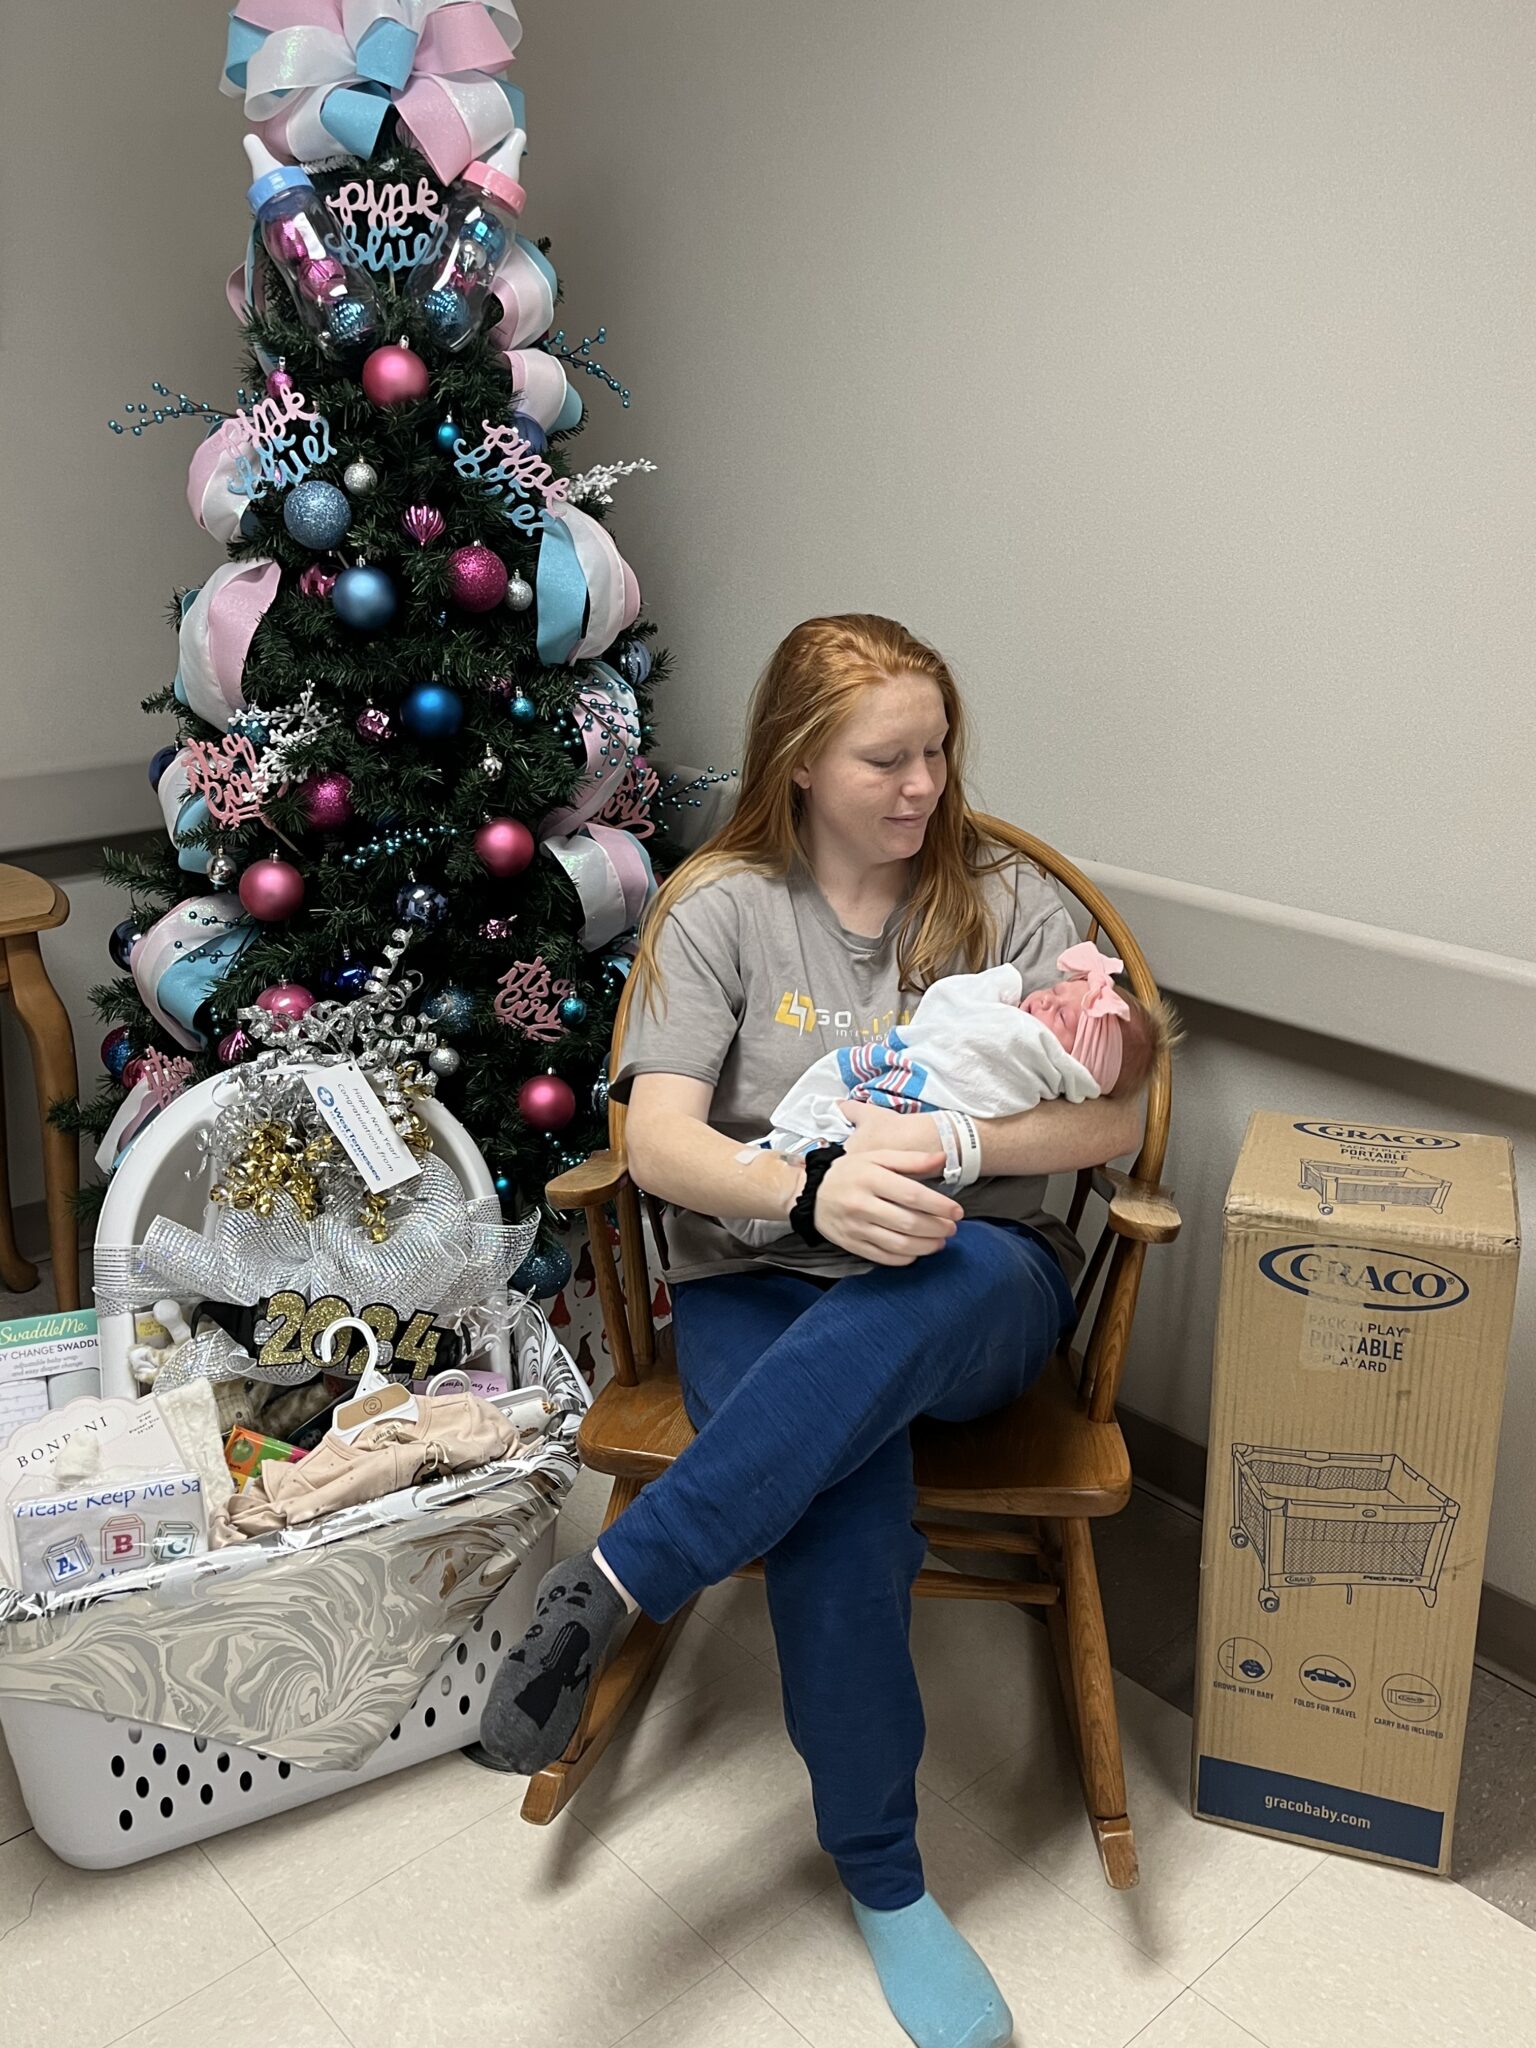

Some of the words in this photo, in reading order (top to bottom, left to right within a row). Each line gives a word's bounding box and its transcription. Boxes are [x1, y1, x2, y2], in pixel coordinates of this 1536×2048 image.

[352, 1087, 372, 1115] Happy
[370, 1116, 385, 1136] New
[337, 1083, 380, 1154] Congratulations
[377, 1150, 395, 1172] from
[1318, 1126, 1443, 1146] GRACO
[333, 1106, 351, 1133] West
[349, 1131, 381, 1181] Tennessee
[1340, 1148, 1408, 1161] PORTABLE
[1350, 1156, 1398, 1164] PLAYARD
[1290, 1253, 1447, 1299] GRACO
[0, 1318, 87, 1346] SwaddleMe
[257, 1289, 442, 1380] 2024
[1367, 1323, 1405, 1338] PLAY
[10, 1345, 56, 1360] CHANGE
[1310, 1329, 1404, 1361] PORTABLE
[1323, 1355, 1388, 1373] PLAYARD
[16, 1415, 108, 1468] BONPNI
[86, 1488, 136, 1508] Keep
[143, 1483, 175, 1500] Me
[112, 1534, 134, 1555] B
[56, 1554, 77, 1576] A
[1293, 1697, 1316, 1710] FOLDS
[1316, 1703, 1330, 1713] FOR
[1332, 1706, 1357, 1719] TRAVEL
[1374, 1717, 1396, 1728] CARRY
[1396, 1722, 1410, 1732] BAG
[1411, 1726, 1444, 1739] INCLUDED
[1264, 1794, 1371, 1830] gracobaby.com
